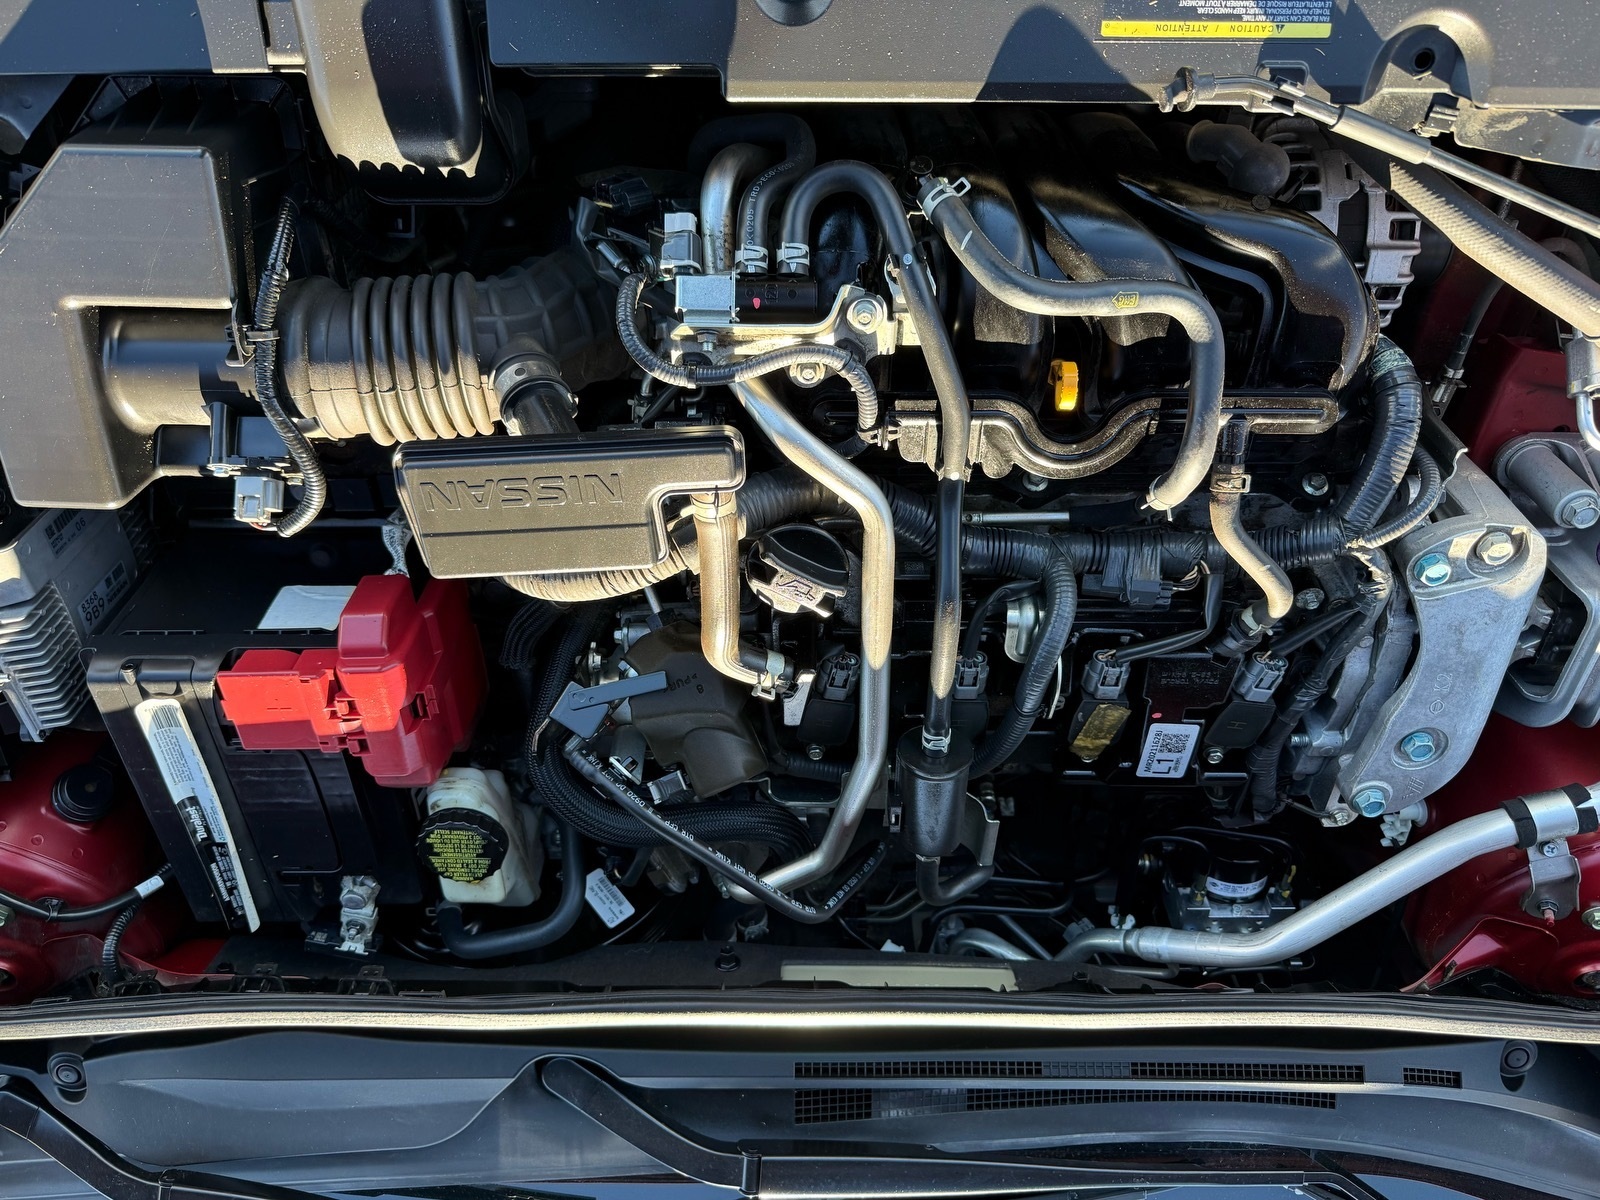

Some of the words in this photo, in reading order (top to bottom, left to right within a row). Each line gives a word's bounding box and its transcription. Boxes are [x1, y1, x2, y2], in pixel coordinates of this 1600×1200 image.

[1266, 0, 1287, 8] RISQUE
[1287, 0, 1325, 8] VENTILATEUR
[1325, 0, 1332, 8] LE
[1232, 7, 1246, 15] KEEP
[1265, 7, 1292, 15] PERSONAL
[1292, 7, 1310, 15] AVOID
[1309, 7, 1322, 15] HELP
[1322, 7, 1330, 15] TO
[1155, 23, 1208, 33] ATTENTION
[1229, 24, 1274, 33] CAUTION
[748, 184, 761, 203] TRD
[418, 473, 623, 513] NISSAN
[80, 590, 99, 614] 8368
[85, 596, 104, 627] 9B9
[1152, 759, 1174, 774] L1
[186, 805, 208, 842] Duralast
